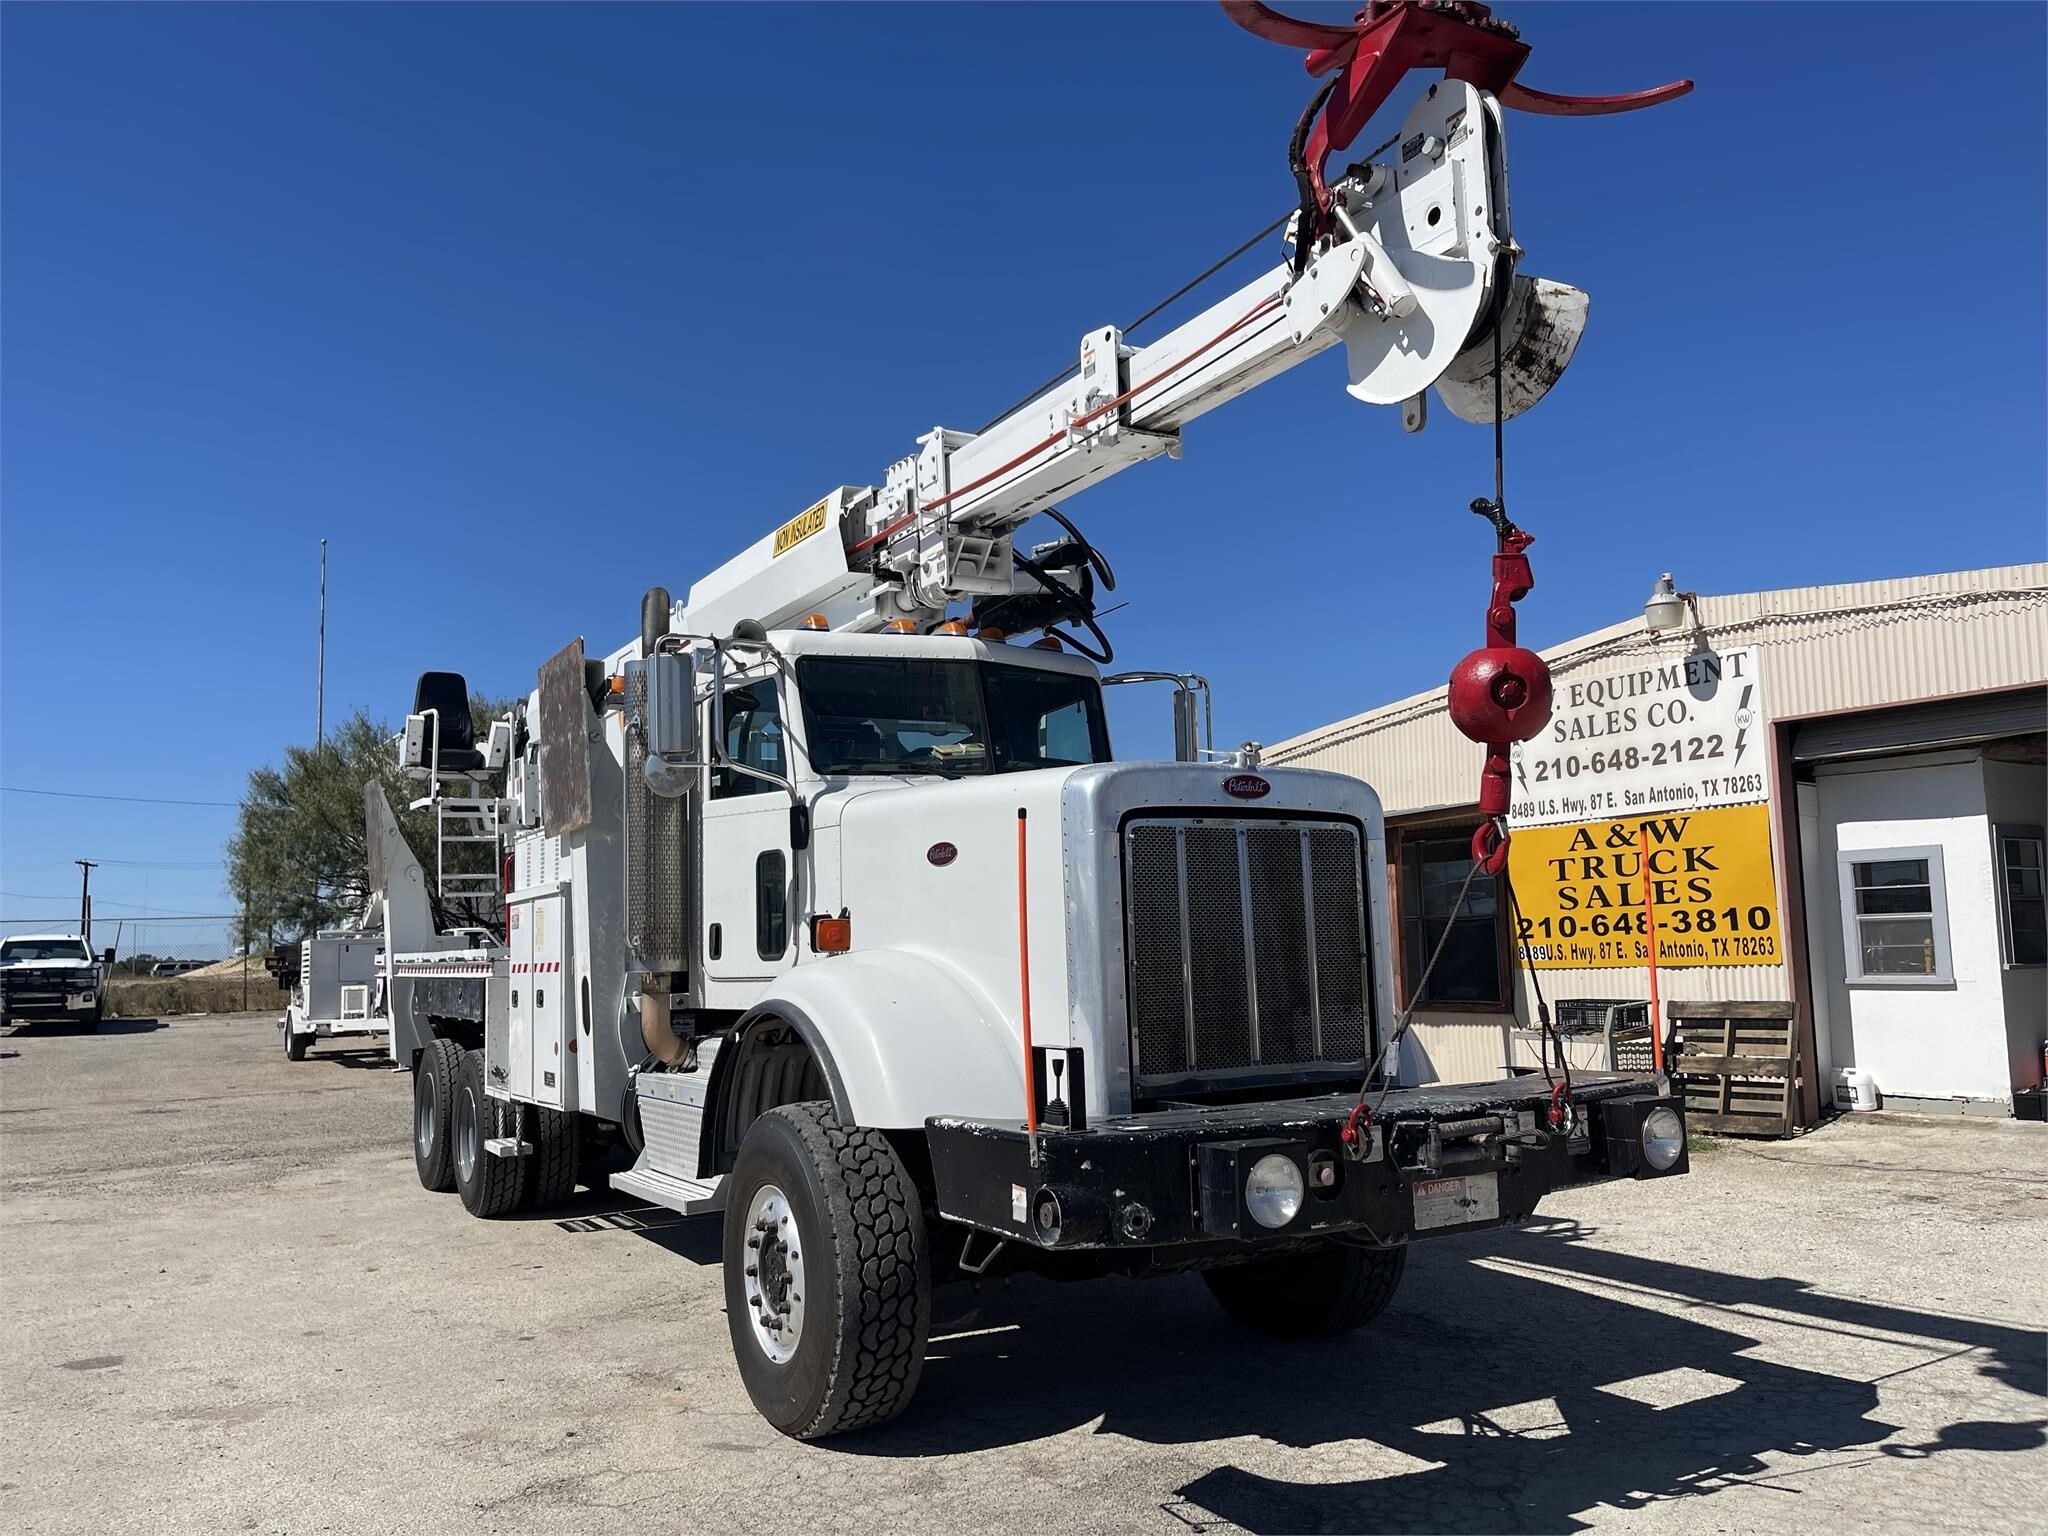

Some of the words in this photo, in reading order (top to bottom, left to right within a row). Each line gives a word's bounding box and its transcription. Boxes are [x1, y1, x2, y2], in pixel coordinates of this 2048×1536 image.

[790, 505, 825, 544] INSULATED
[1570, 652, 1747, 708] EQUIPMENT
[1554, 707, 1638, 743] SALES
[1647, 699, 1695, 728] CO.
[1535, 735, 1724, 782] 210-648-2122
[1511, 803, 1536, 820] 8489
[1538, 799, 1559, 817] U.S.
[1562, 796, 1588, 816] Hwy.
[1590, 793, 1604, 810] 87
[1607, 792, 1618, 808] E.
[1624, 788, 1646, 807] San
[1649, 781, 1699, 804] Antonio,
[1701, 777, 1719, 797] TX
[1722, 773, 1763, 794] 78263
[1548, 845, 1720, 882] TRUCK
[1557, 877, 1713, 911] SALES
[1516, 905, 1772, 940] 210-648-3810
[1571, 942, 1597, 965] Hwy.
[1599, 943, 1613, 960] 87
[1616, 941, 1628, 960] E.
[1634, 940, 1655, 959] Sa
[1659, 936, 1709, 961] Antonio,
[1711, 936, 1730, 957] TX
[1732, 934, 1775, 957] 78263
[1427, 1181, 1461, 1194] DANGER
